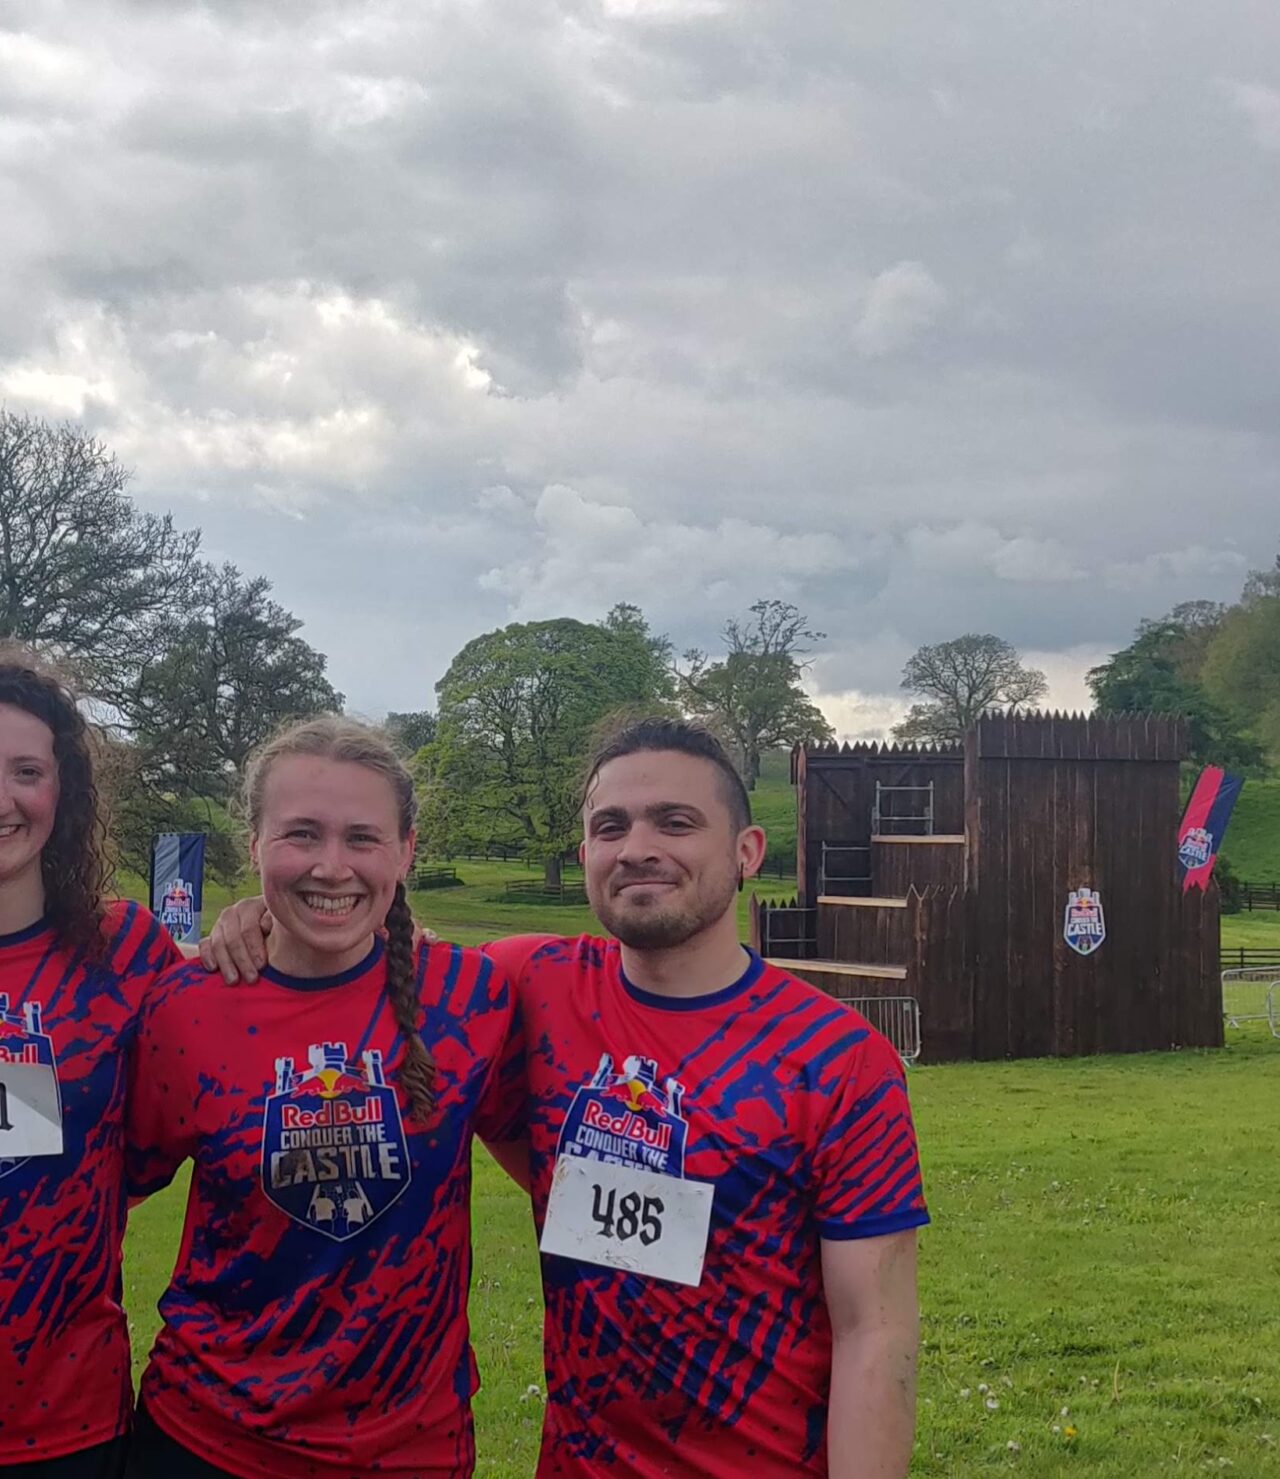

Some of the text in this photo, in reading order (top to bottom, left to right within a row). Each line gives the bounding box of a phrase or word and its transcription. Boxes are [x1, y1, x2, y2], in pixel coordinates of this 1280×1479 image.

[162, 912, 192, 925] CASTLE
[1068, 922, 1102, 936] CASTLE
[280, 1124, 386, 1150] CONQUER THE
[575, 1125, 638, 1160] CONQUER
[642, 1147, 668, 1171] THE
[271, 1142, 401, 1189] CASTLE
[592, 1183, 665, 1247] 485
